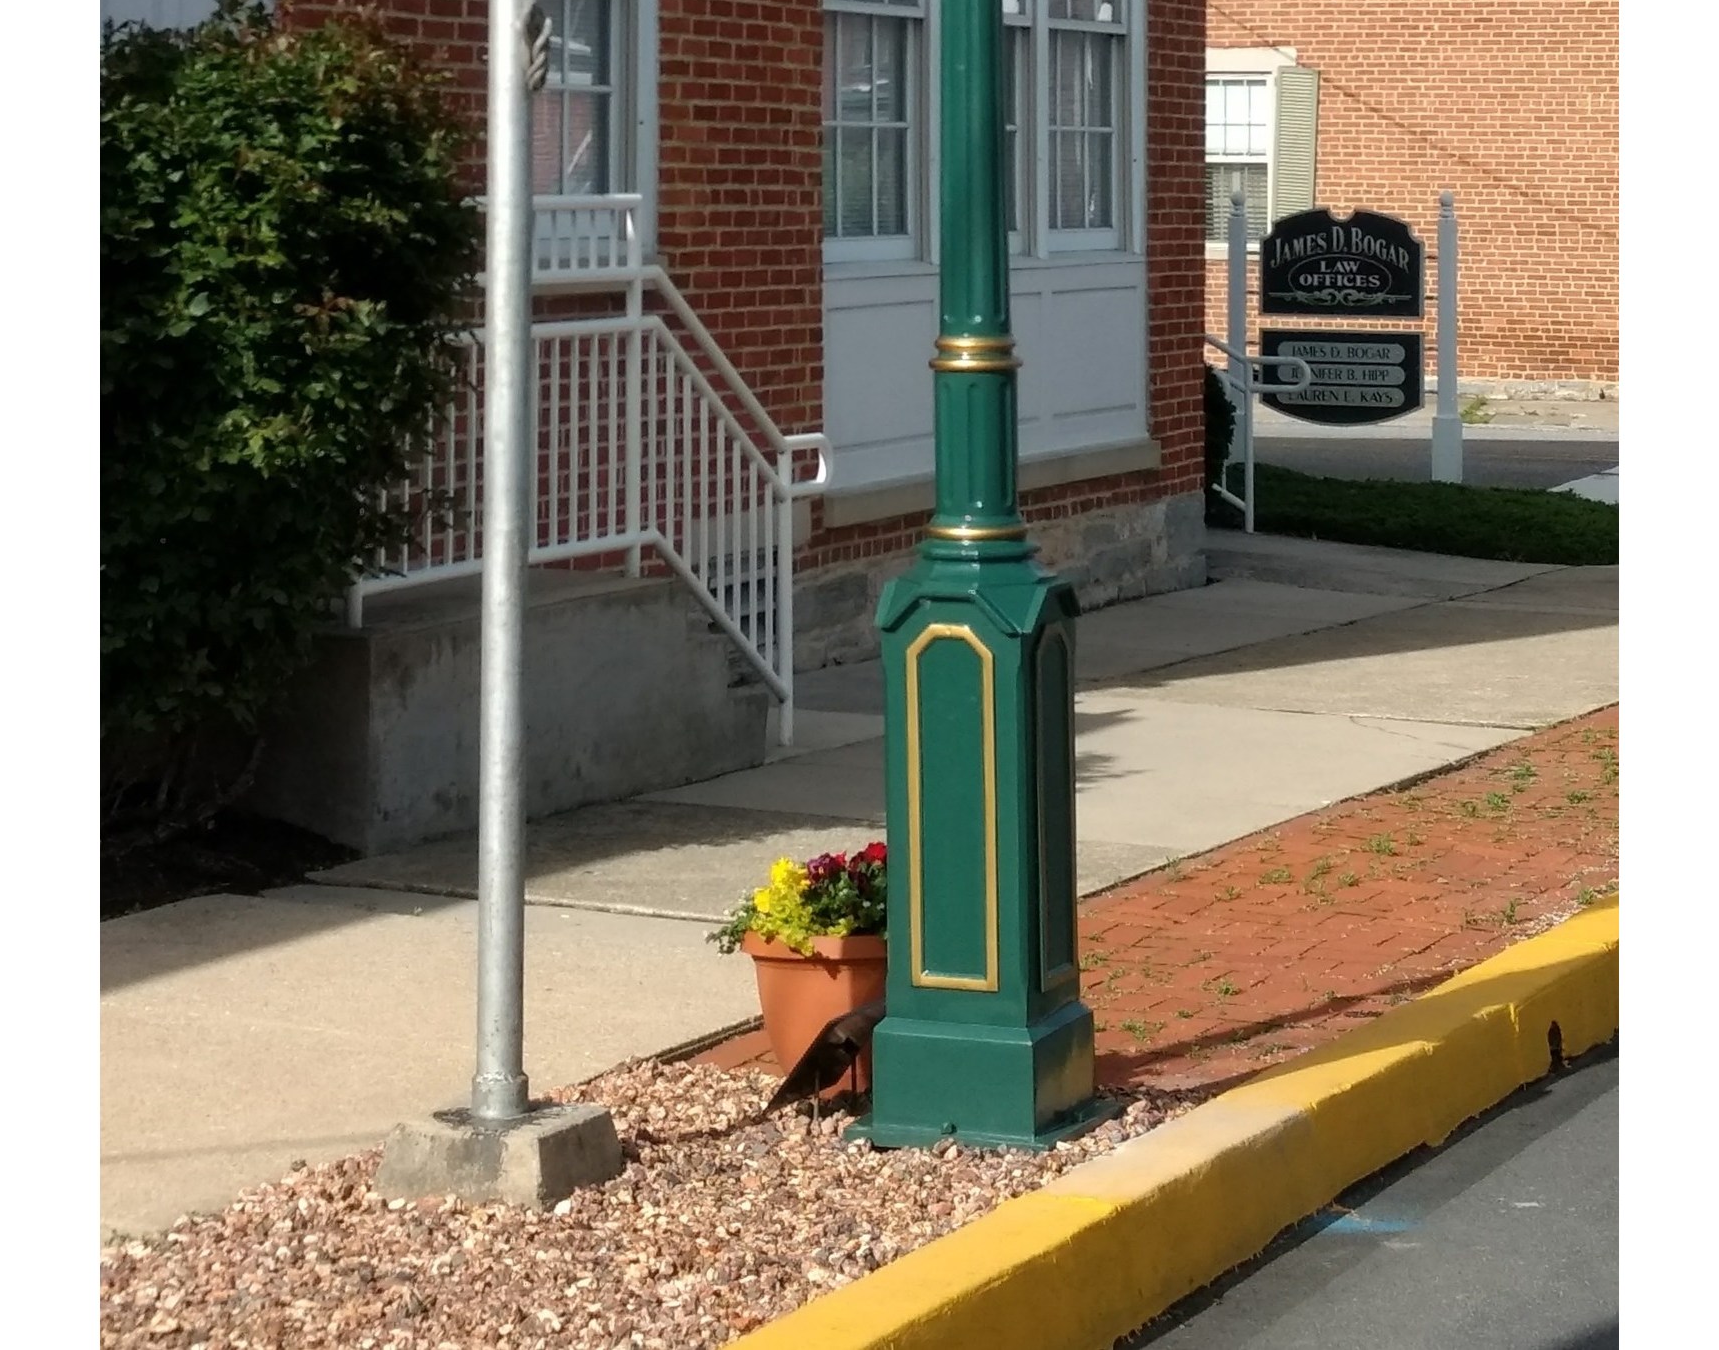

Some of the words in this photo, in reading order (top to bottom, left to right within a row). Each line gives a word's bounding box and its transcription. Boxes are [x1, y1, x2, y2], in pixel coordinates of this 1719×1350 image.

[1270, 232, 1328, 269] JAMES
[1332, 226, 1348, 253] D.
[1351, 227, 1410, 274] BOGAR
[1319, 261, 1361, 274] LAW
[1299, 274, 1381, 288] OFFICES
[1291, 345, 1327, 358] JAMES
[1330, 347, 1343, 359] D.
[1347, 347, 1391, 360] BOGAR
[1291, 367, 1343, 382] JENIFER
[1347, 369, 1358, 381] B.
[1362, 369, 1389, 382] HIPP
[1360, 390, 1393, 404] KAYS
